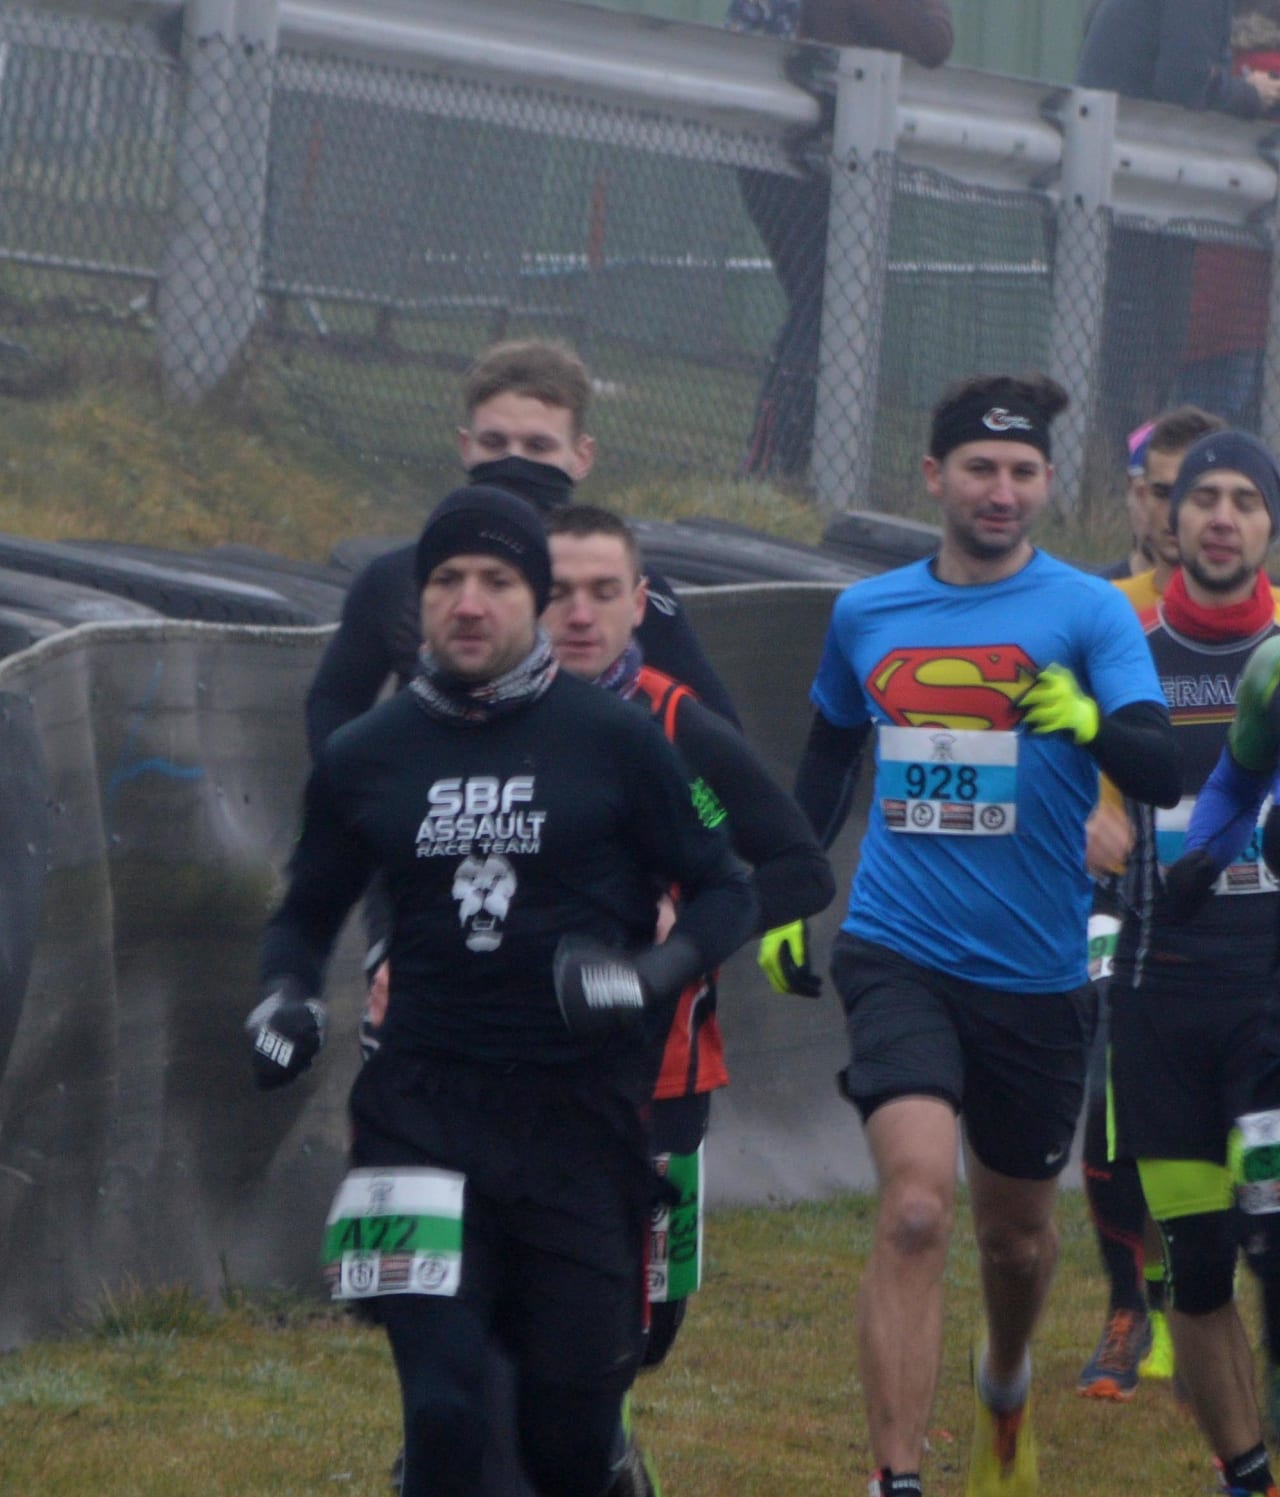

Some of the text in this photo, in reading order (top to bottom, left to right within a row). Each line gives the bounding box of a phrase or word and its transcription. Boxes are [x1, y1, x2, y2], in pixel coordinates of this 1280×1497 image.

[426, 775, 536, 818] SBF
[905, 762, 979, 801] 928
[414, 809, 548, 844] ASSAULT
[415, 838, 541, 859] RACE TEAM
